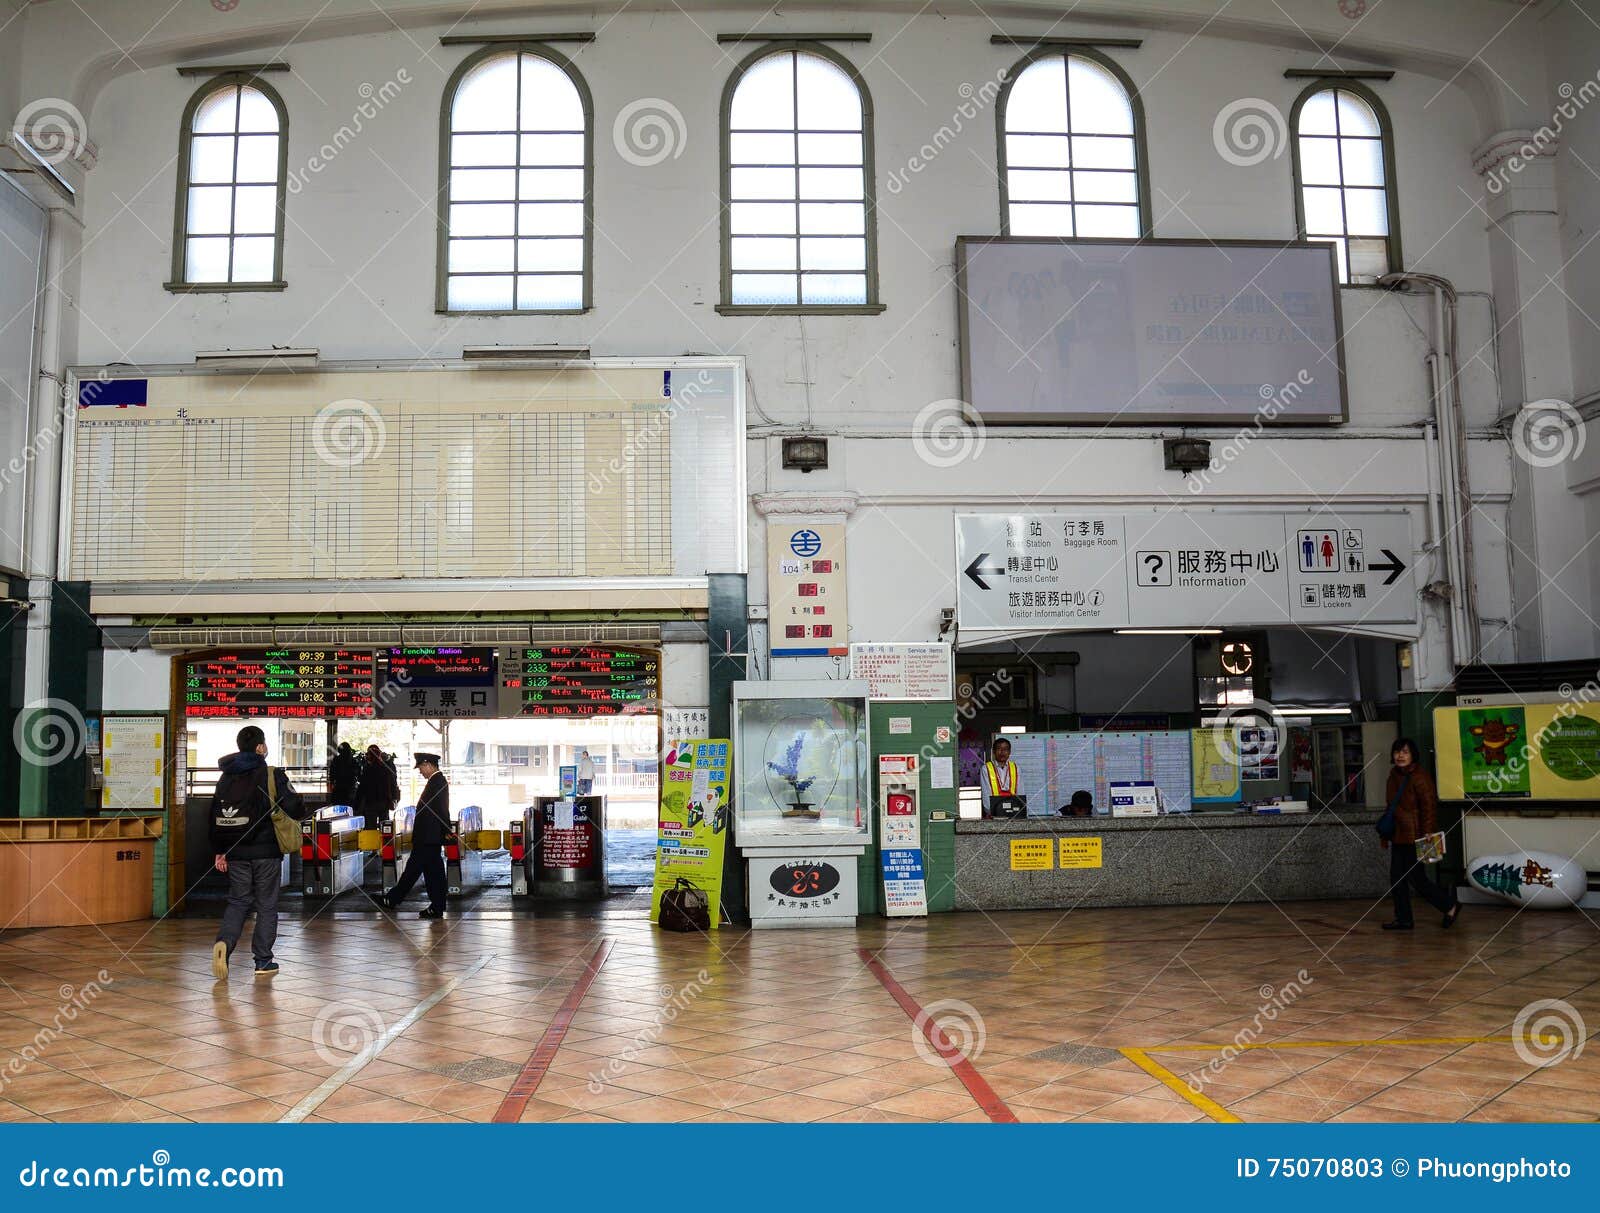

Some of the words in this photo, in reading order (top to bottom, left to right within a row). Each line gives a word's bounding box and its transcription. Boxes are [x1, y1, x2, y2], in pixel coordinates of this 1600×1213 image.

[177, 408, 188, 418] 北
[1064, 520, 1105, 536] 行李房
[1026, 540, 1051, 548] Station
[1064, 539, 1095, 548] Baggage
[1097, 538, 1118, 547] Room
[1008, 556, 1059, 572] 轉運中心
[1177, 549, 1280, 574] 服務中心
[783, 565, 799, 574] 104
[1008, 575, 1032, 584] Transit
[1034, 574, 1059, 583] Center
[1178, 576, 1247, 588] Information
[1321, 584, 1367, 599] 儲物櫃
[1008, 591, 1085, 607] 旅遊服務中心
[1009, 610, 1033, 619] Visitor
[1034, 609, 1075, 618] Information
[1077, 609, 1101, 618] Center
[299, 652, 325, 661] 09:39
[504, 648, 518, 660] 上
[299, 666, 325, 675] 09:48
[527, 663, 548, 673] 2332
[298, 680, 324, 688] 09:54
[299, 693, 325, 702] 10:02
[409, 689, 487, 707] 剪票口
[419, 709, 448, 717] Ticket
[454, 709, 477, 717] Gate
